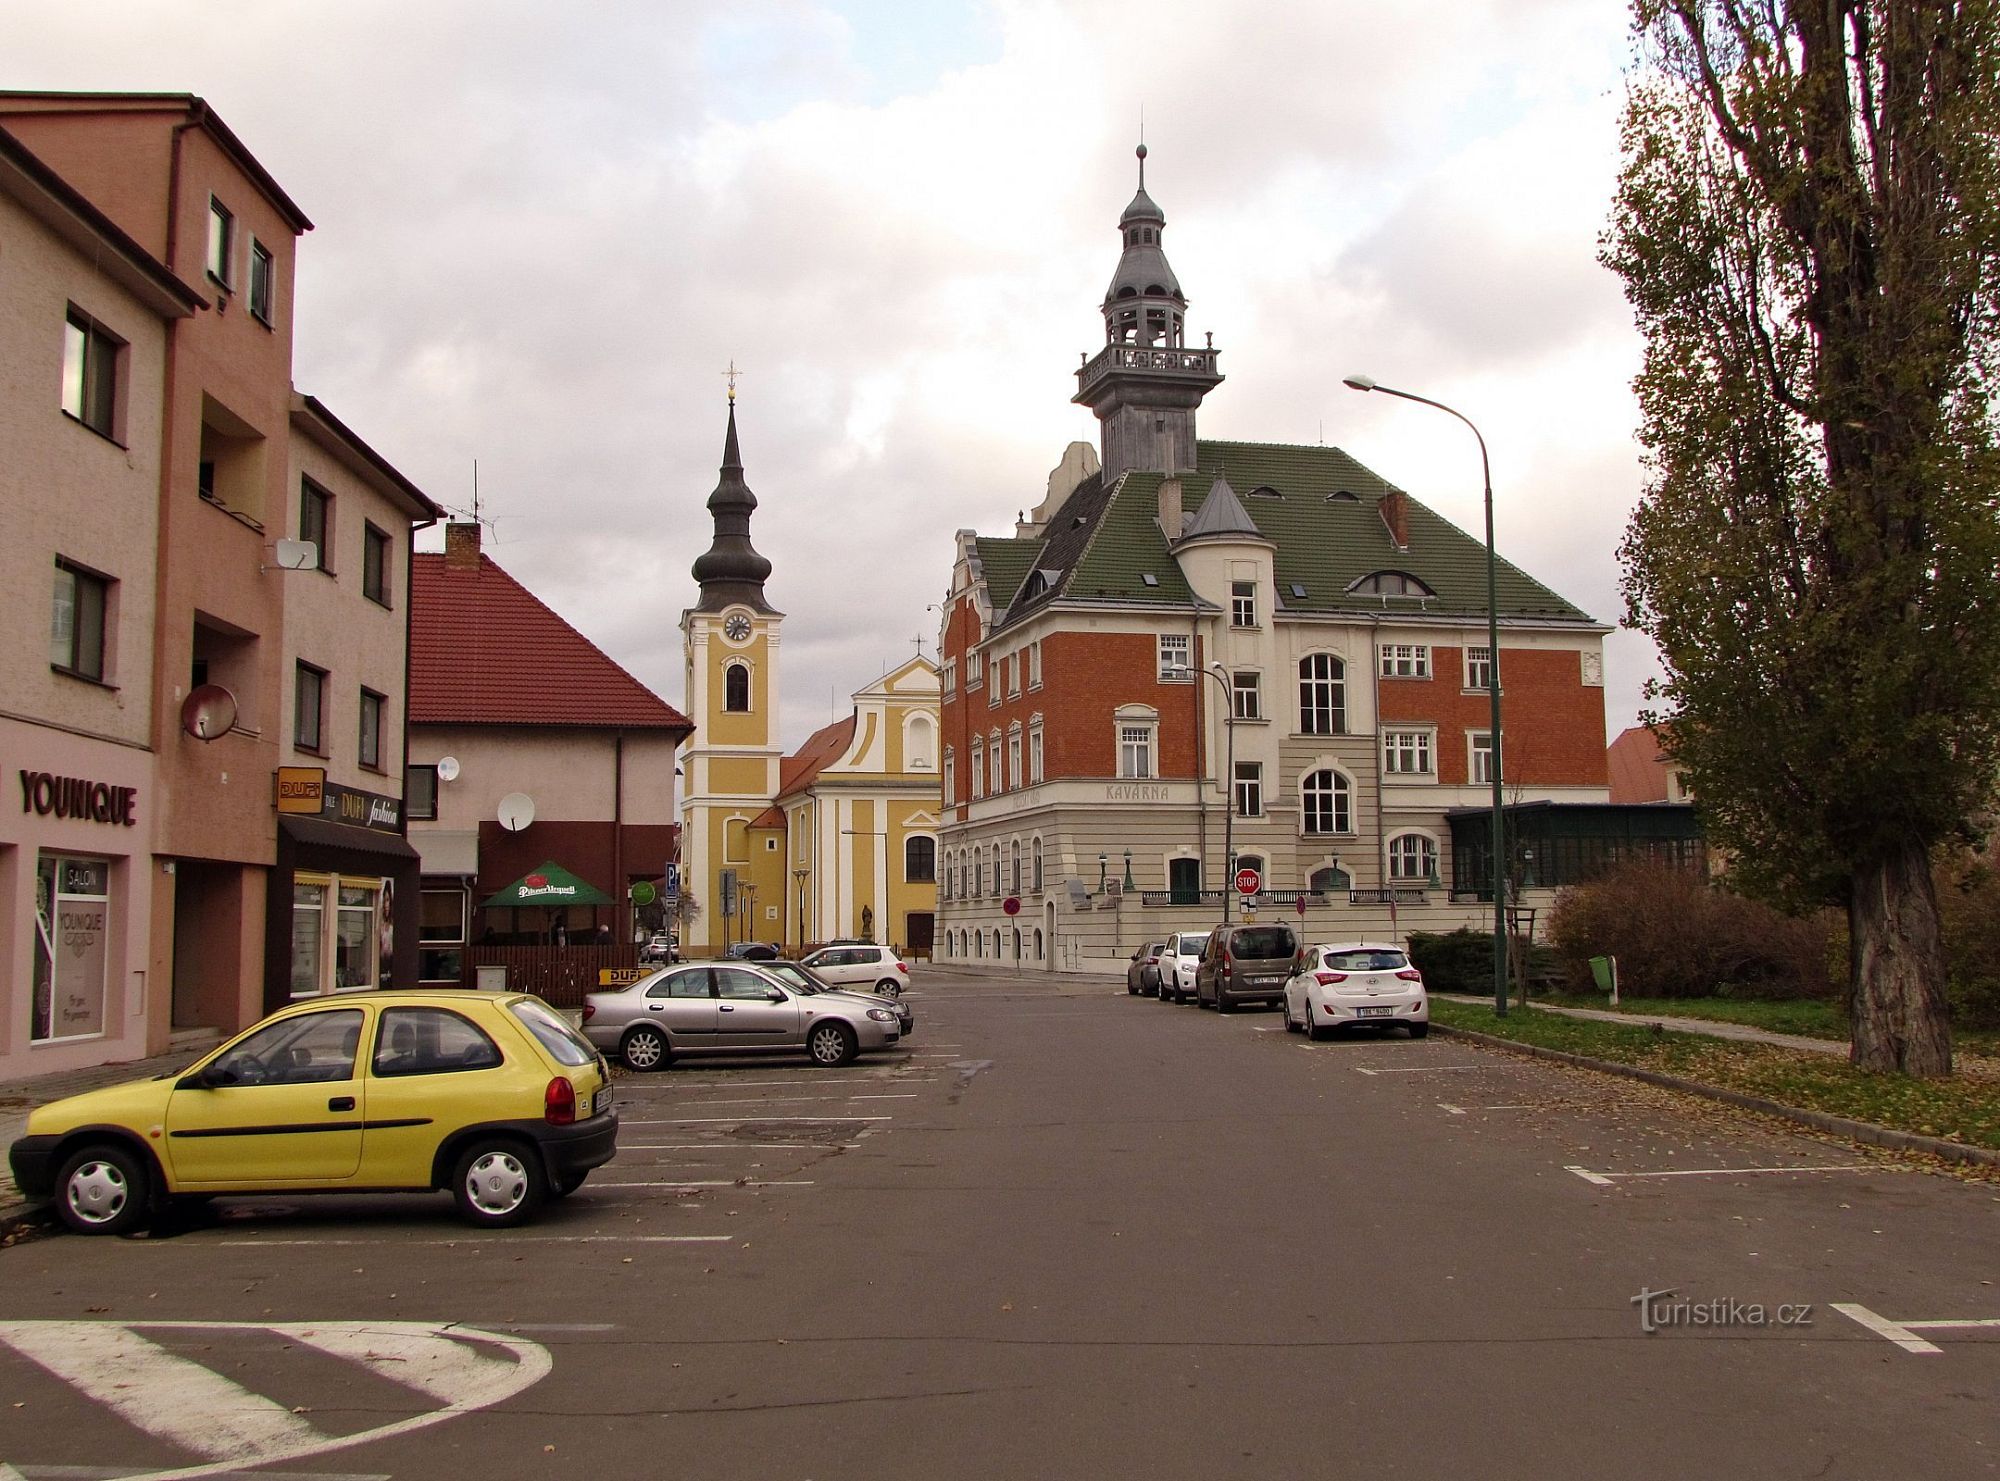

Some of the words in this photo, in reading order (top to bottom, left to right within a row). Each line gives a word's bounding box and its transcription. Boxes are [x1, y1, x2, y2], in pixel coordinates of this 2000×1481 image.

[19, 769, 137, 827] YOUNIQUE
[1106, 783, 1169, 800] KAVÁRNA
[342, 793, 365, 820] DUFI
[366, 798, 397, 827] fashion
[68, 868, 97, 887] SALON
[668, 866, 675, 887] P
[1237, 878, 1257, 888] STOP
[518, 886, 548, 898] Pilsner
[60, 911, 102, 931] YOUNIQUE
